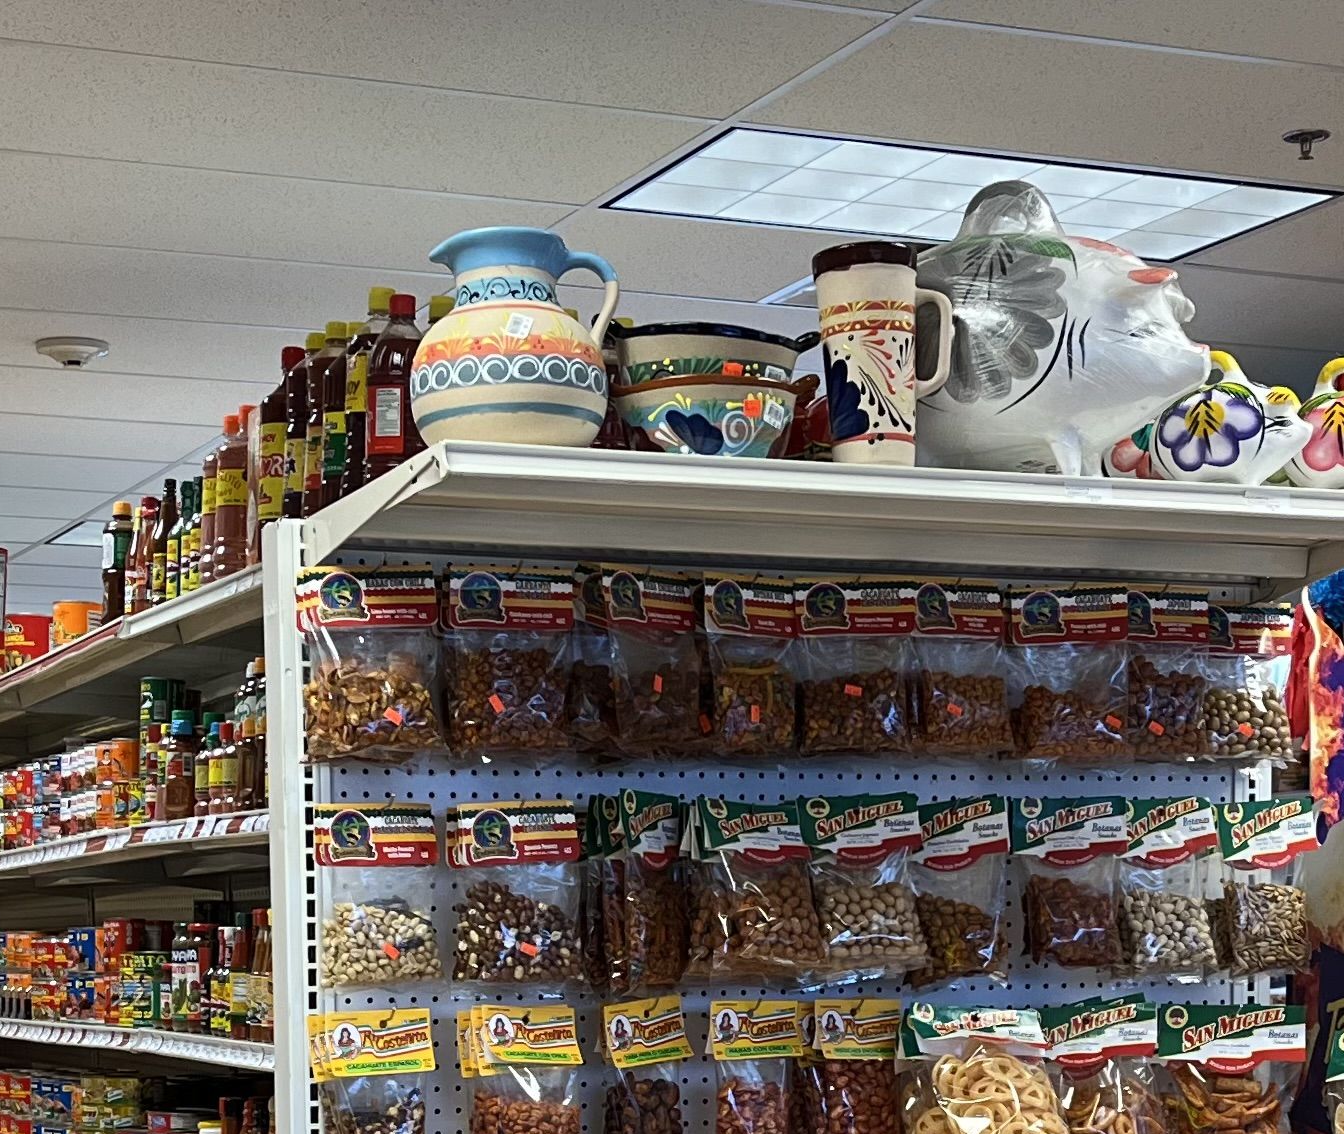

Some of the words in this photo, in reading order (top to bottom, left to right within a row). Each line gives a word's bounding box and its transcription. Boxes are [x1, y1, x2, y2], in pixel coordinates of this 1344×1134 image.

[719, 817, 741, 840] SAN
[742, 811, 787, 833] MIGUEL
[815, 817, 843, 841] SAN
[845, 800, 904, 829] MIGUEL
[933, 801, 992, 832] MIGUEL
[1026, 819, 1055, 843] SAN
[1056, 801, 1114, 832] MIGUEL
[1149, 797, 1199, 829] MIGUEL
[1230, 824, 1255, 850] SAN
[1255, 802, 1302, 833] MIGUEL
[1069, 1004, 1137, 1039] MIGUEL
[1182, 1027, 1213, 1051] SAN
[1216, 1006, 1285, 1038] MIGUEL
